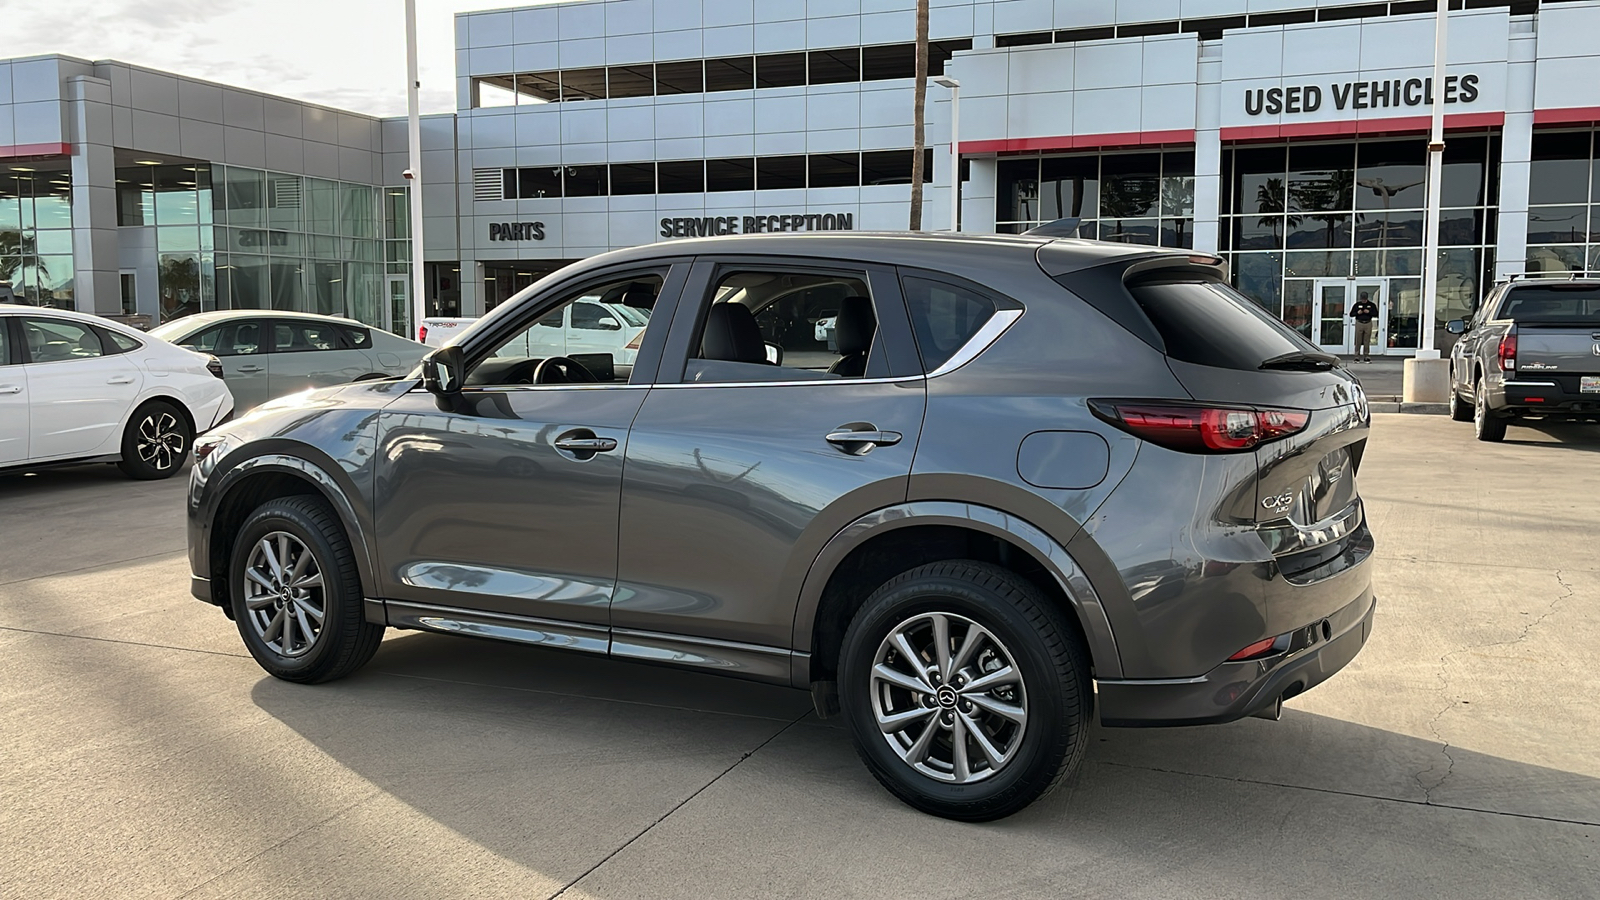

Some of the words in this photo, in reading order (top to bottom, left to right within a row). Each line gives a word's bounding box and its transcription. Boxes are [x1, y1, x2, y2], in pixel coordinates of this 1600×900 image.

[1245, 86, 1322, 115] USED
[1331, 74, 1479, 111] VEHICLES
[489, 221, 545, 241] PARTS
[660, 217, 739, 238] SERVICE
[742, 213, 853, 234] RECEPTION
[1261, 492, 1292, 509] CX-5
